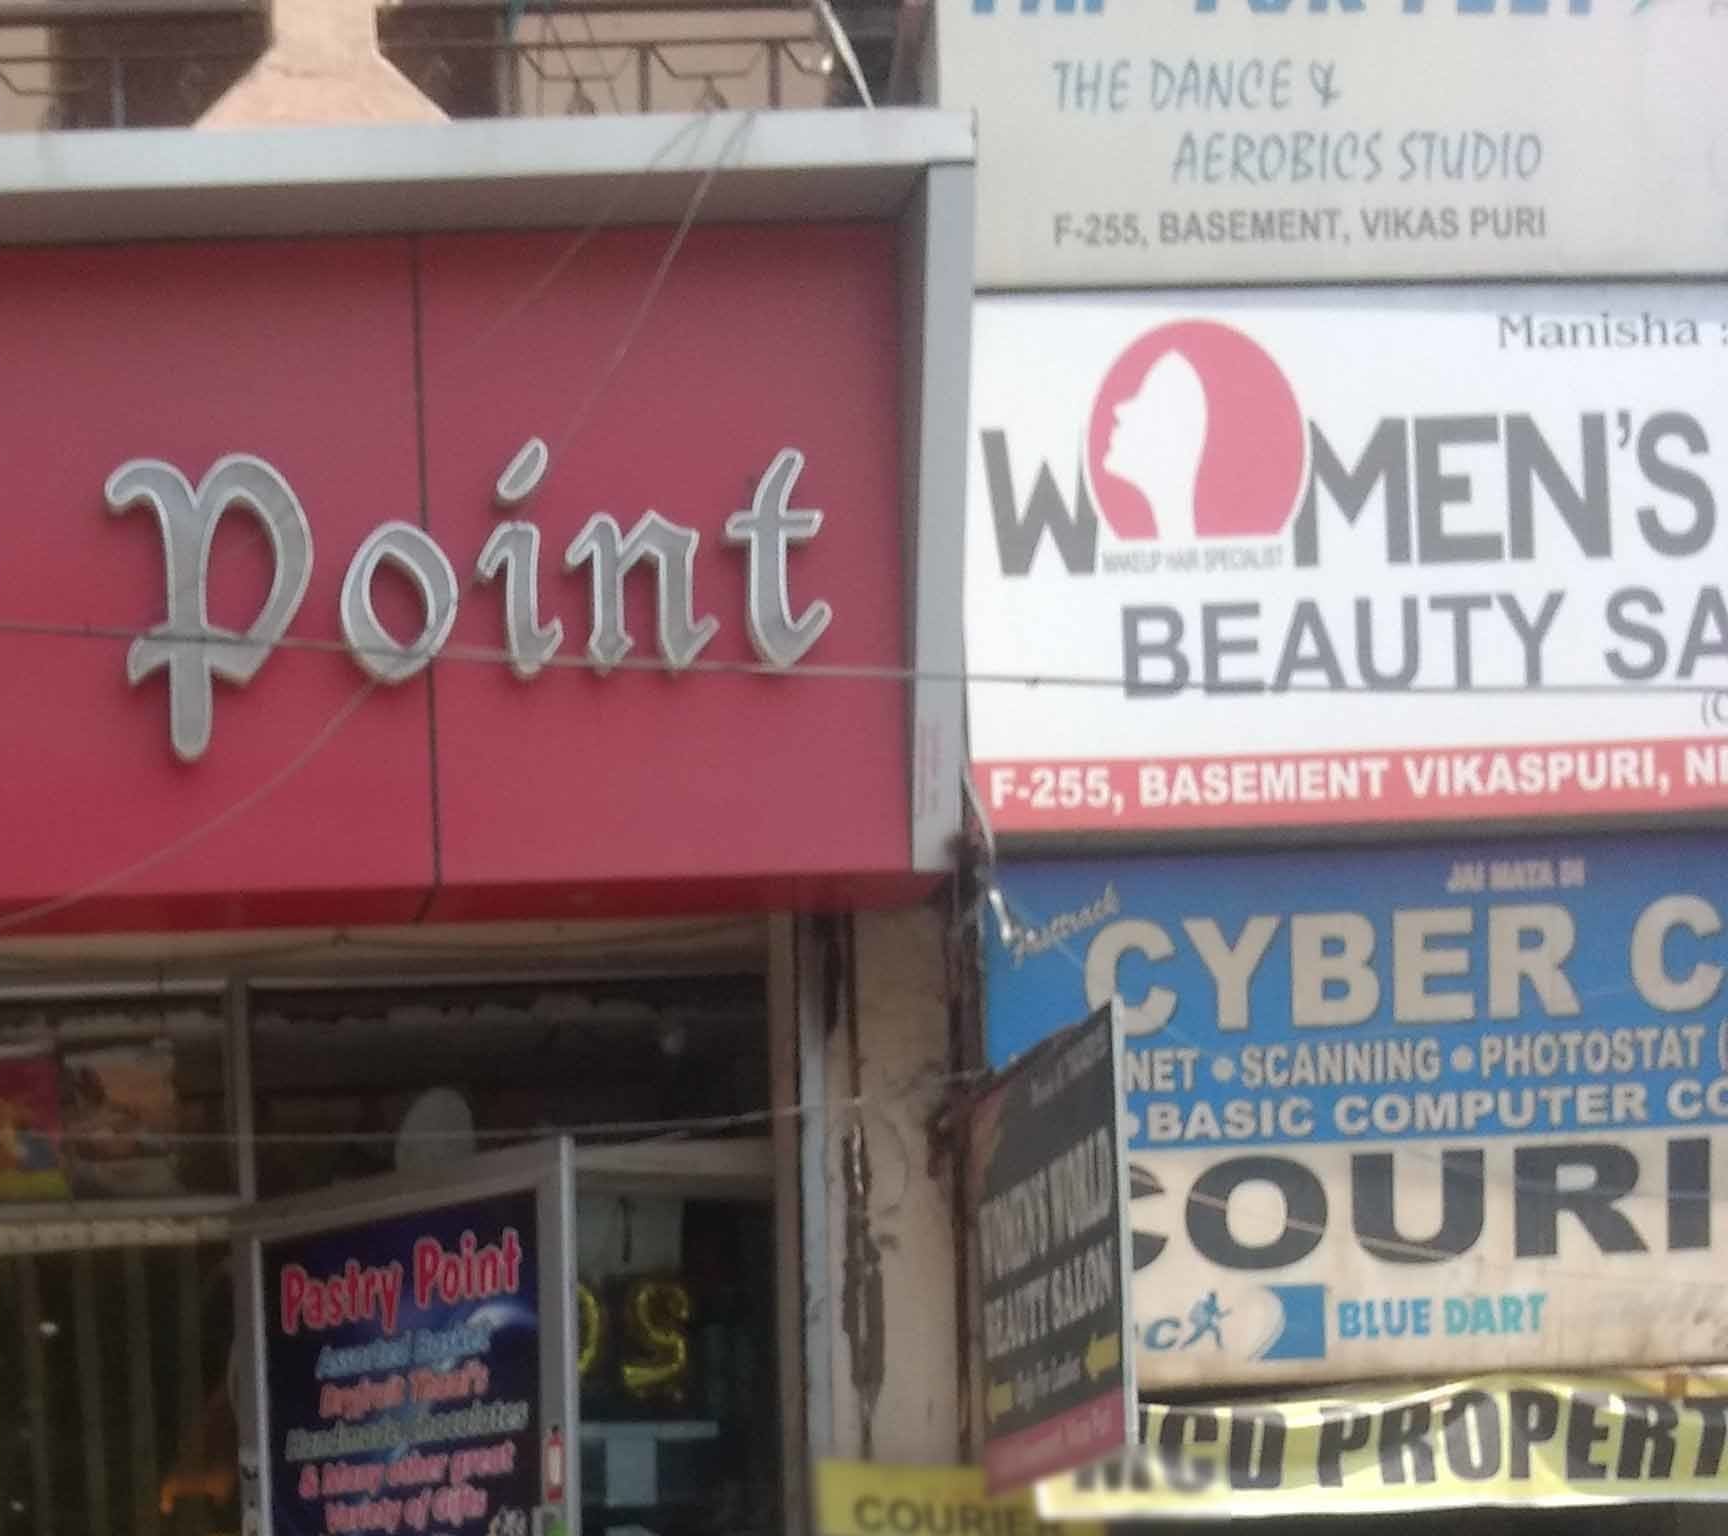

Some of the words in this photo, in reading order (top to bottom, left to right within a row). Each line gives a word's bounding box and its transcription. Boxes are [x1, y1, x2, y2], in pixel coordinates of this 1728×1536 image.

[1052, 58, 1133, 113] THE
[1149, 56, 1294, 112] DANCE
[1312, 60, 1342, 102] &
[1172, 130, 1382, 186] AEROBICS
[1398, 129, 1543, 183] STUDIO
[1053, 211, 1148, 248] F-255,
[1158, 207, 1350, 245] BASEMENT,
[1361, 206, 1459, 240] VIKAS
[1471, 204, 1546, 237] PURI
[1498, 312, 1700, 349] Manisha
[104, 437, 833, 762] Point
[1121, 589, 1565, 700] BEAUTY
[990, 764, 1125, 814] F-255,
[1139, 757, 1390, 807] BASEMENT
[1403, 748, 1671, 800] VIKASPURI,
[1084, 903, 1582, 1038] CYBER
[1240, 1036, 1441, 1088] SCANNING
[1479, 1025, 1705, 1080] PHOTOSTAT
[1148, 1092, 1315, 1142] BASIC
[1333, 1081, 1649, 1138] COMPUTER
[281, 1259, 404, 1335] Pastry
[413, 1227, 524, 1309] Point
[1337, 1296, 1432, 1341] BLUE
[1444, 1291, 1550, 1337] DART
